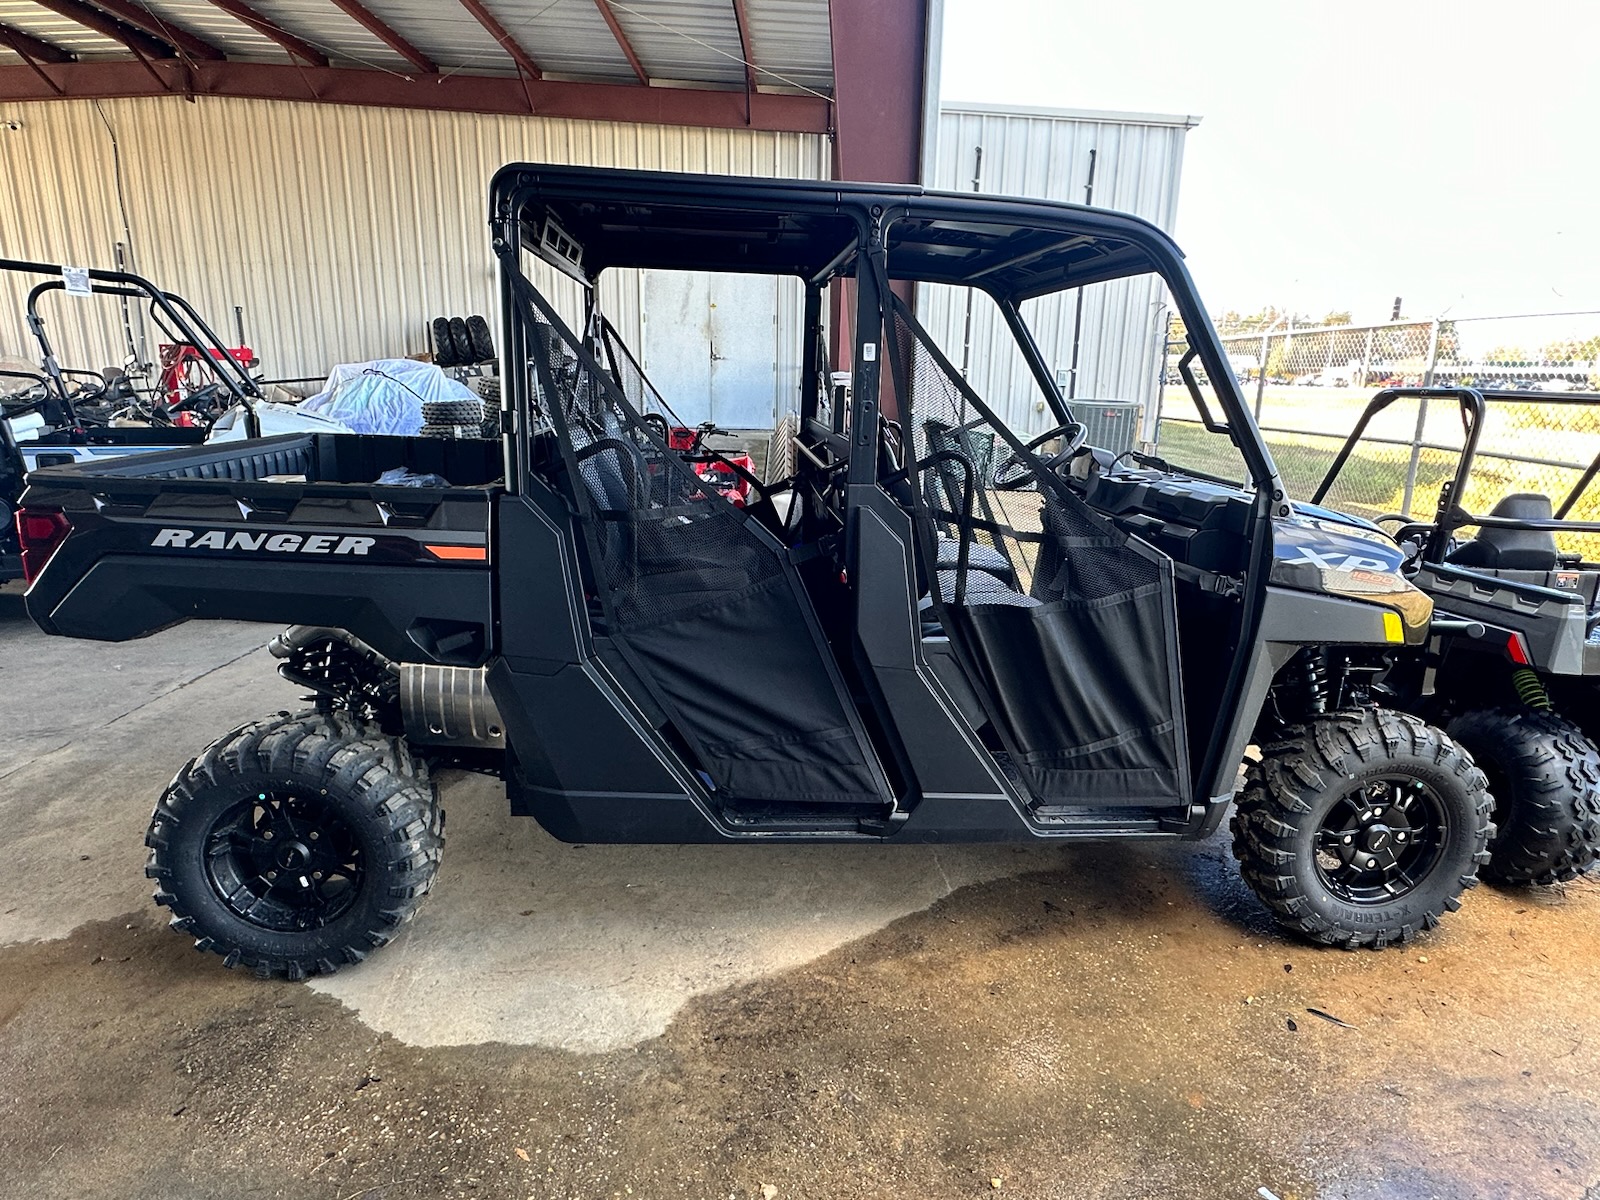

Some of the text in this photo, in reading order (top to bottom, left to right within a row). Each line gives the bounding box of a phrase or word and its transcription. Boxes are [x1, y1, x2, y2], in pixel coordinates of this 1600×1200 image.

[151, 528, 376, 555] RANGER
[1280, 546, 1390, 573] XP
[1351, 570, 1396, 585] 1000
